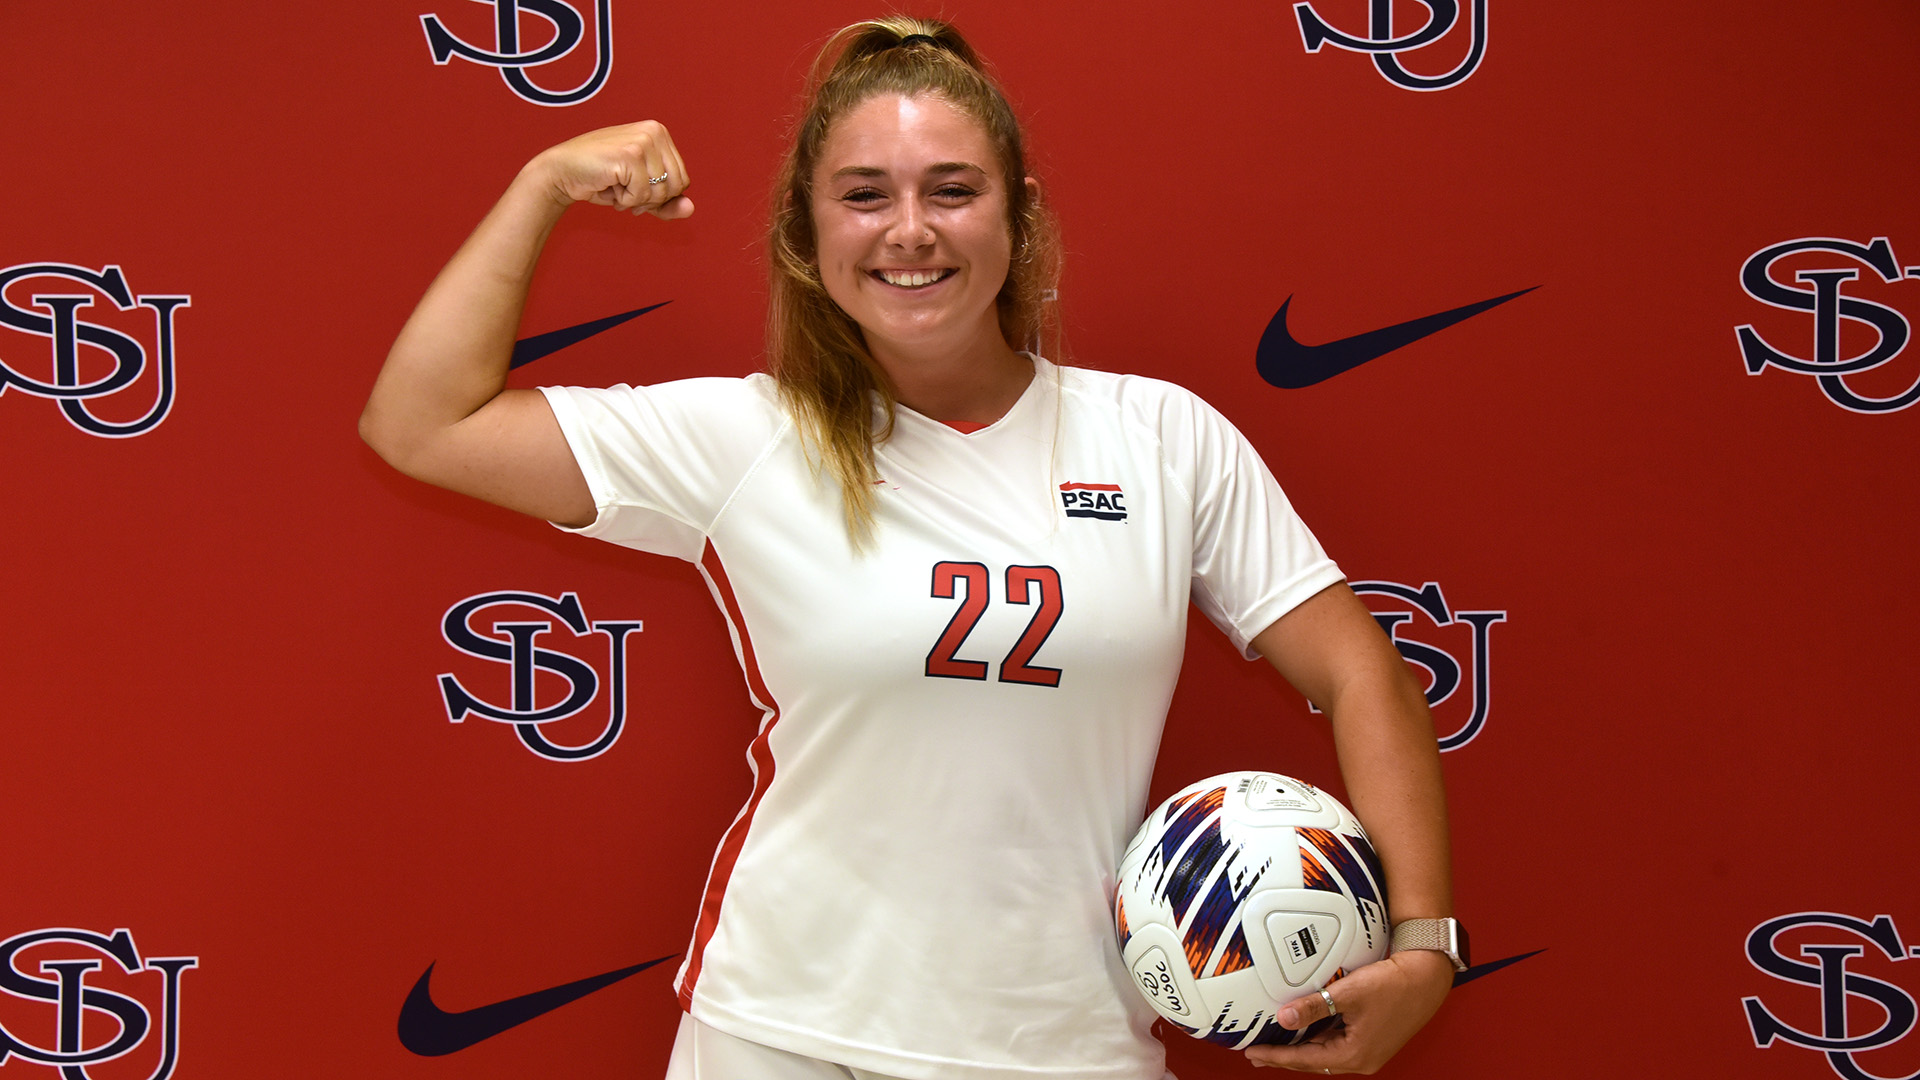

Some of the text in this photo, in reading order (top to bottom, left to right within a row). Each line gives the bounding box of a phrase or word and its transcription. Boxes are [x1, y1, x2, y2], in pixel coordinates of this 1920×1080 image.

[0, 262, 191, 438] SU
[1061, 491, 1127, 511] PSAC
[437, 590, 643, 762] SU
[925, 560, 1064, 688] 22
[0, 928, 198, 1080] SU
[1291, 940, 1302, 957] FIFA
